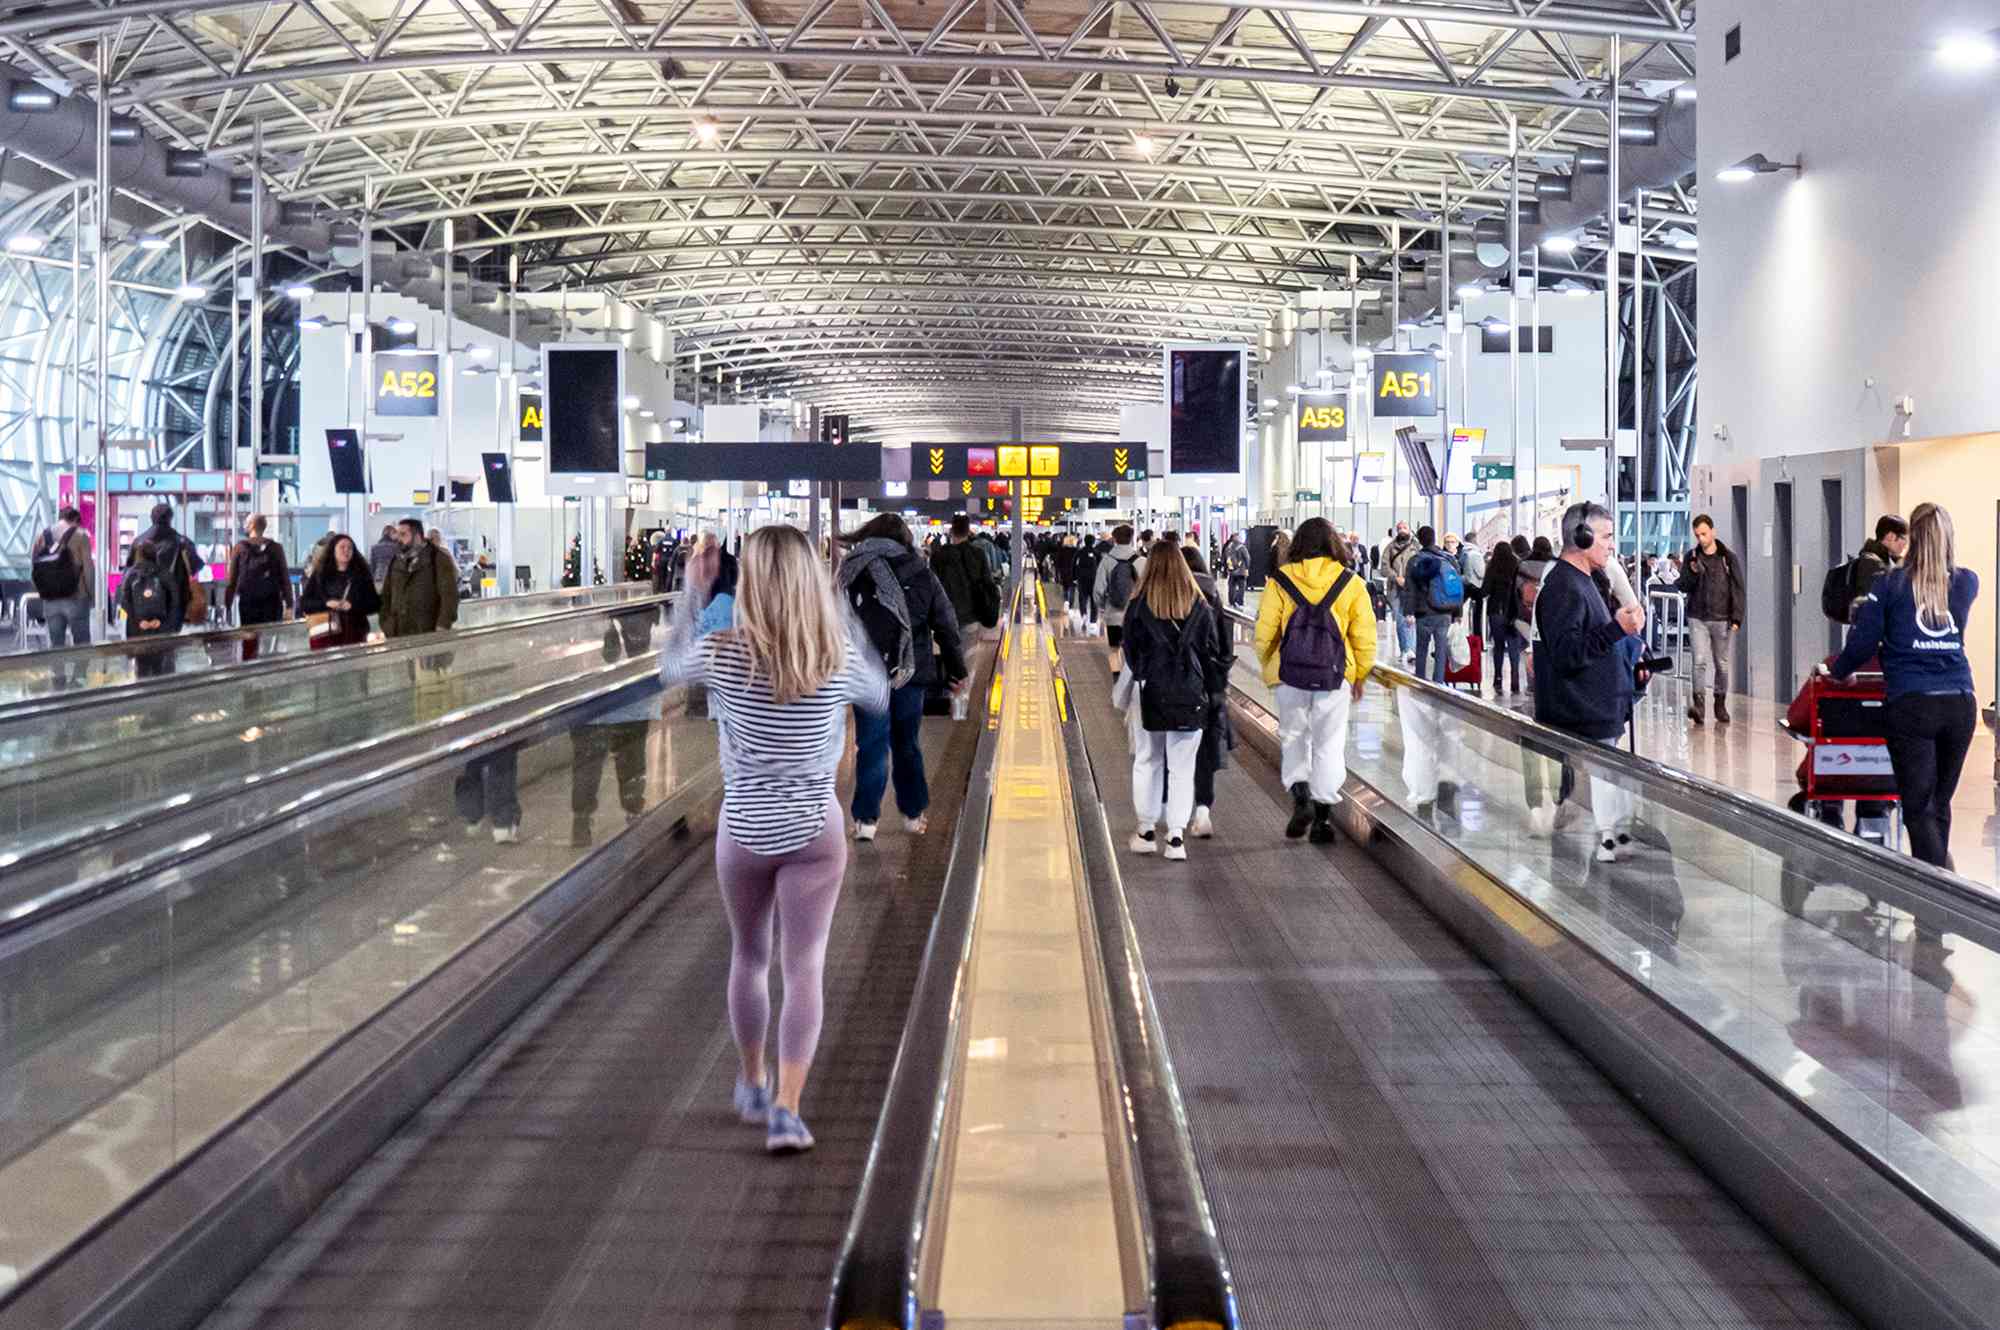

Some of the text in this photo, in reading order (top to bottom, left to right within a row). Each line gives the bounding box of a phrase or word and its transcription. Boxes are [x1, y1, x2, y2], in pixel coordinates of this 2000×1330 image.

[379, 369, 436, 397] A52
[1380, 370, 1431, 398] A51
[1300, 406, 1345, 429] A53
